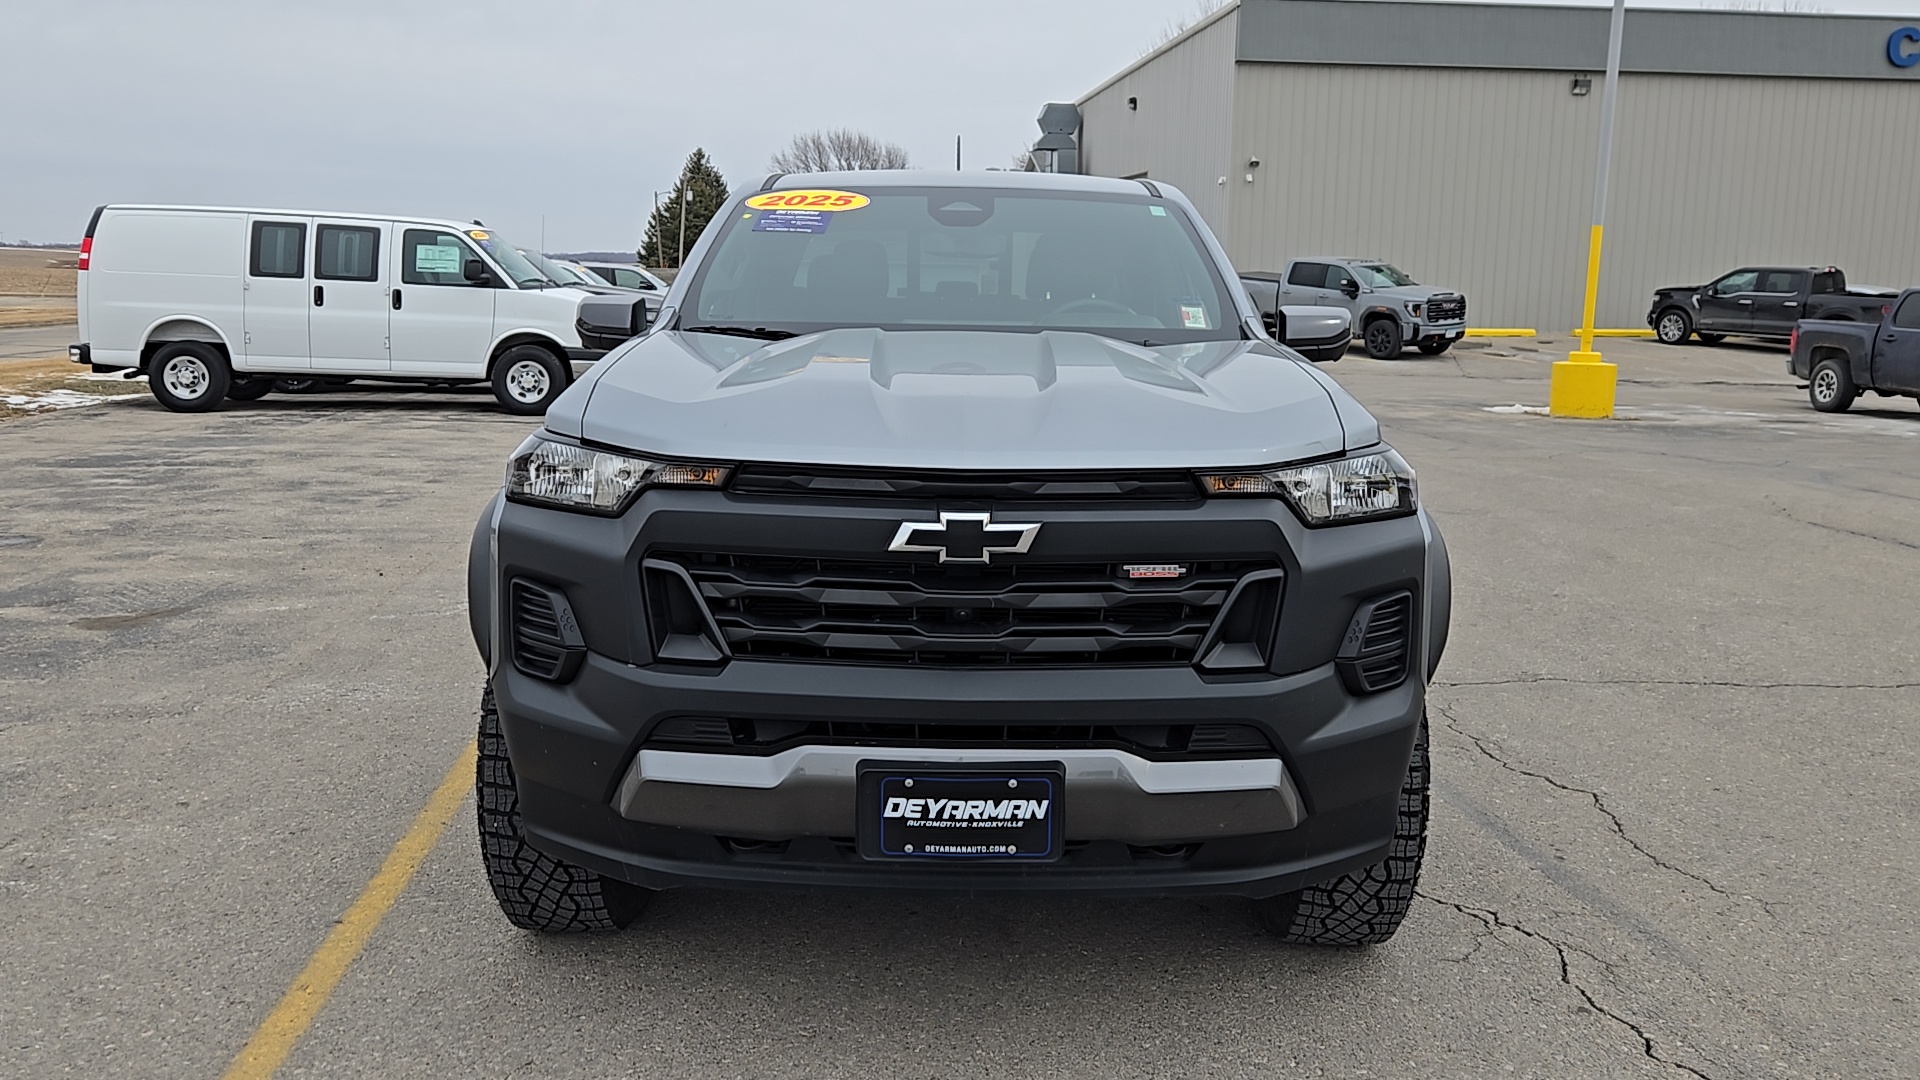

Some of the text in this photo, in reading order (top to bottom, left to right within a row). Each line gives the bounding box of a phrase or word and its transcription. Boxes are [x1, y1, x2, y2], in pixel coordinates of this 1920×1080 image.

[757, 194, 857, 207] 2025
[883, 796, 1050, 820] DEYARMAN
[924, 844, 1007, 853] DEYARMANAUTO.COM
